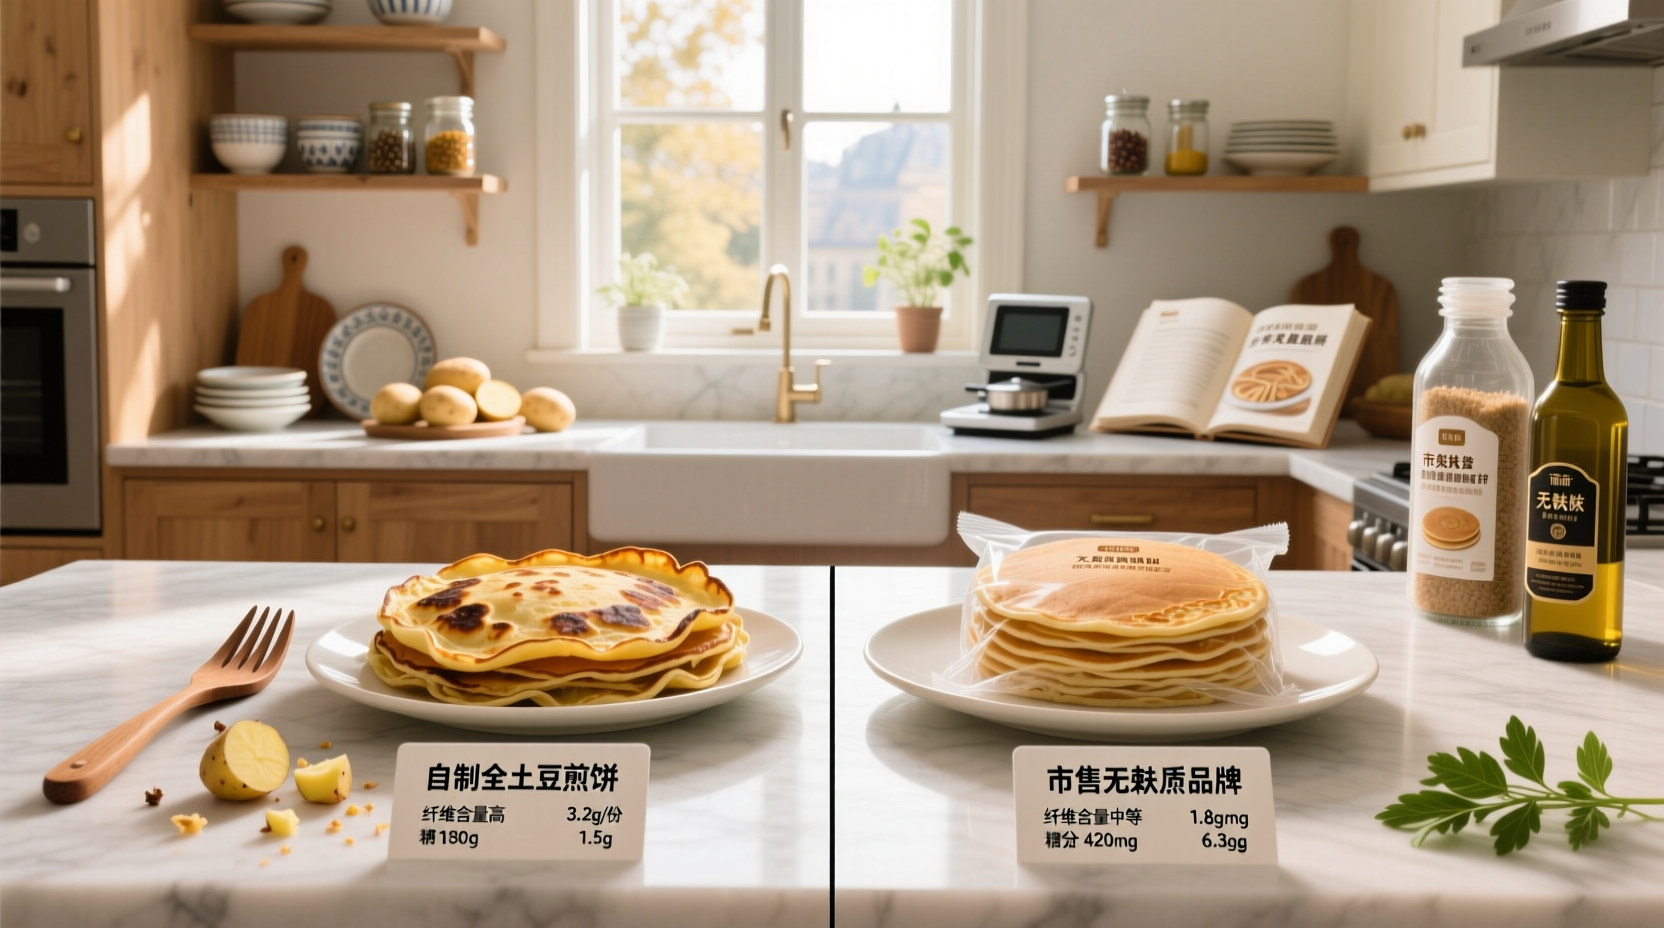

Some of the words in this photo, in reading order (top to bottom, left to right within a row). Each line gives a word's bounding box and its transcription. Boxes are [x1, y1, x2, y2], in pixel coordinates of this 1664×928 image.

[427, 763, 619, 792] 自制全土豆煎饼
[566, 806, 623, 825] 3.2g/份
[1189, 809, 1249, 829] 1.8gmg
[579, 830, 613, 849] 1.5g
[1083, 832, 1138, 852] 420mg
[1201, 833, 1248, 853] 6.3gg
